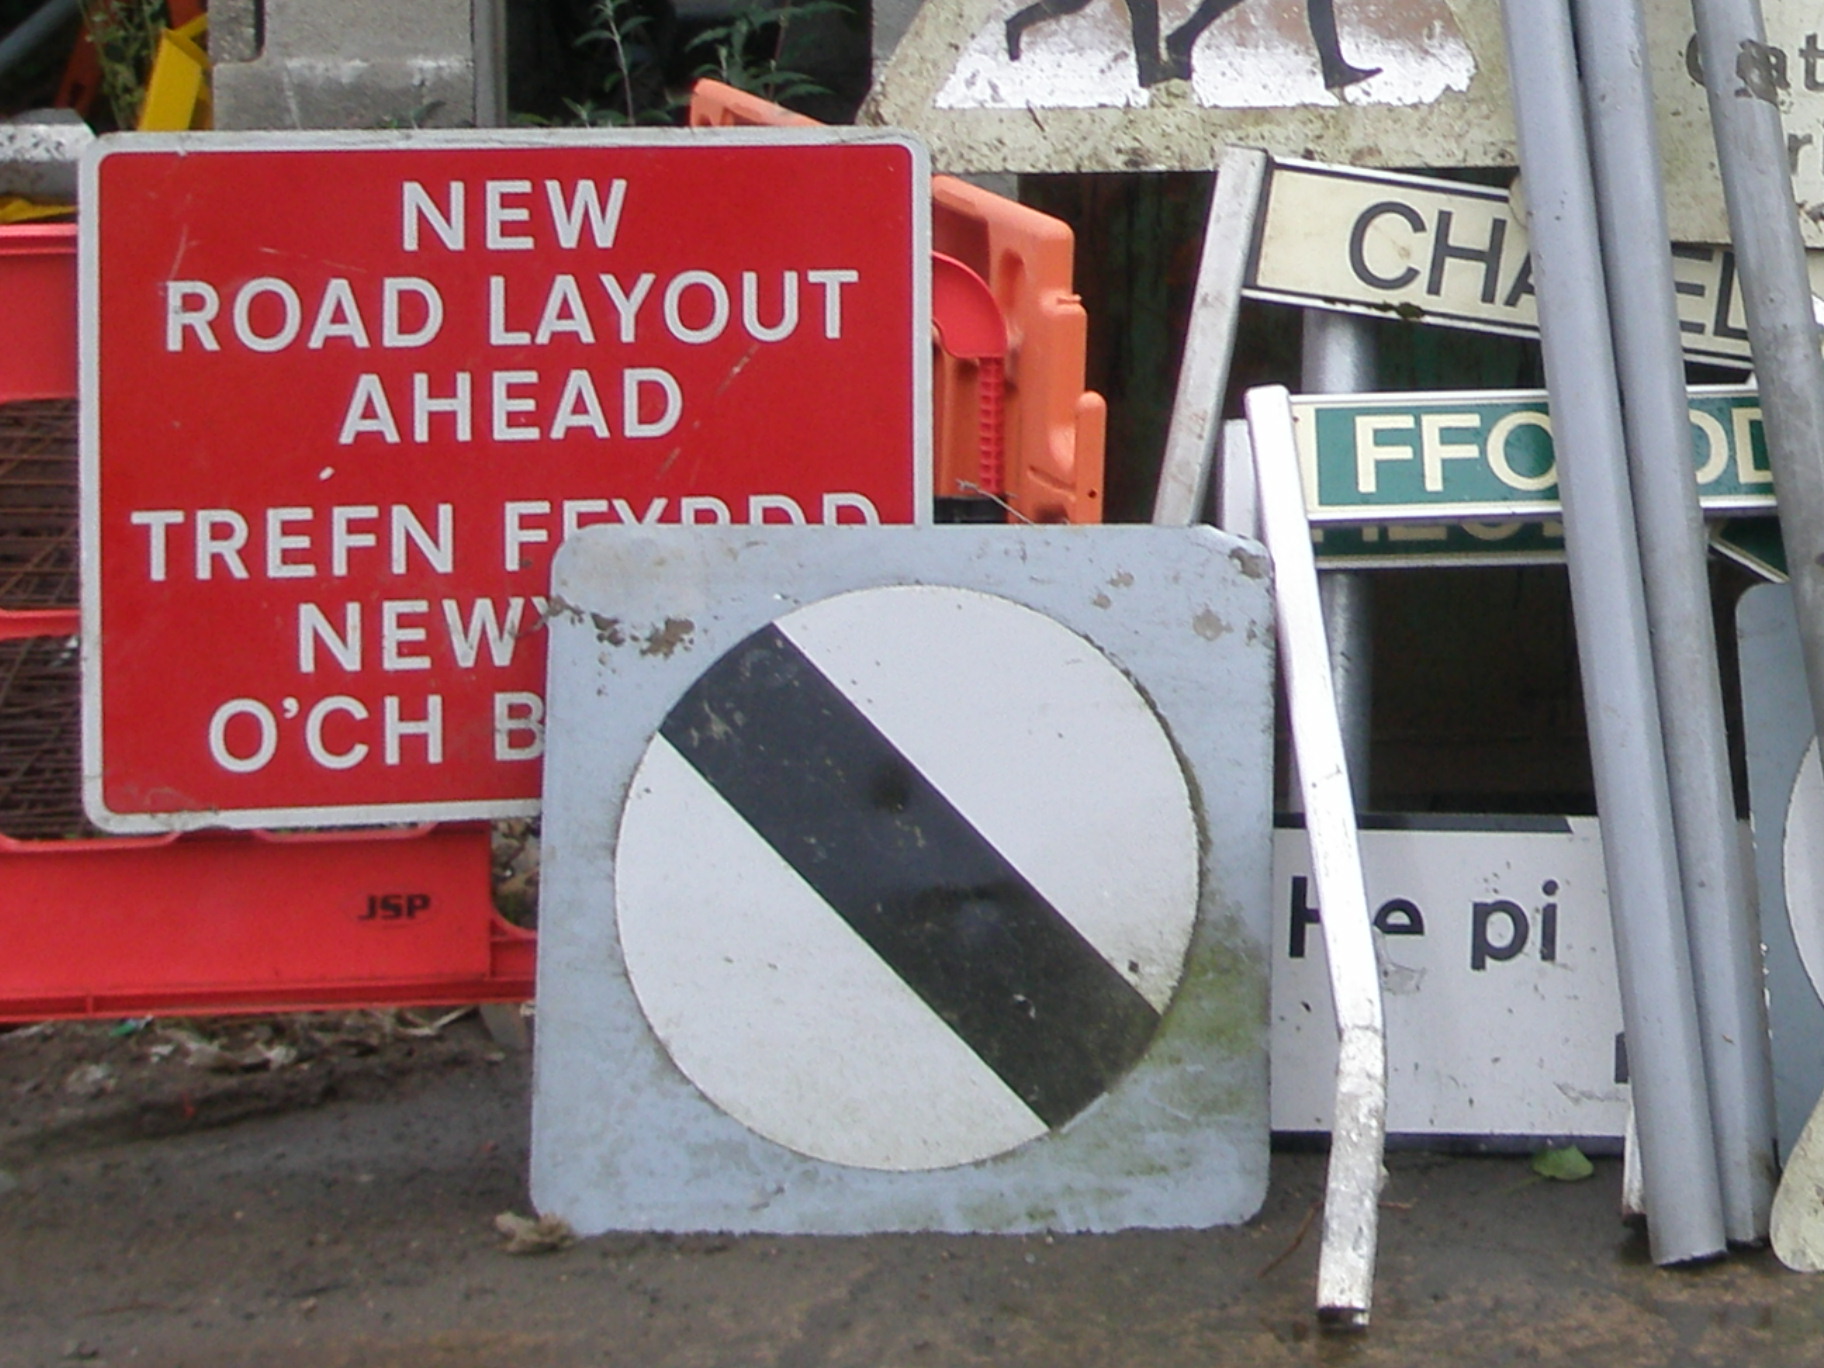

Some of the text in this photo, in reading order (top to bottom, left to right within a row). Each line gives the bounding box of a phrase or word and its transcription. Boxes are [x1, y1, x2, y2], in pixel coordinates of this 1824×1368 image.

[402, 178, 628, 253] NEW
[164, 269, 859, 354] ROAD LAYOUT
[338, 367, 684, 446] AHEAD
[130, 502, 455, 582] TREFN
[299, 596, 547, 675] NEW
[208, 692, 443, 775] O'CH
[357, 892, 432, 921] JSP
